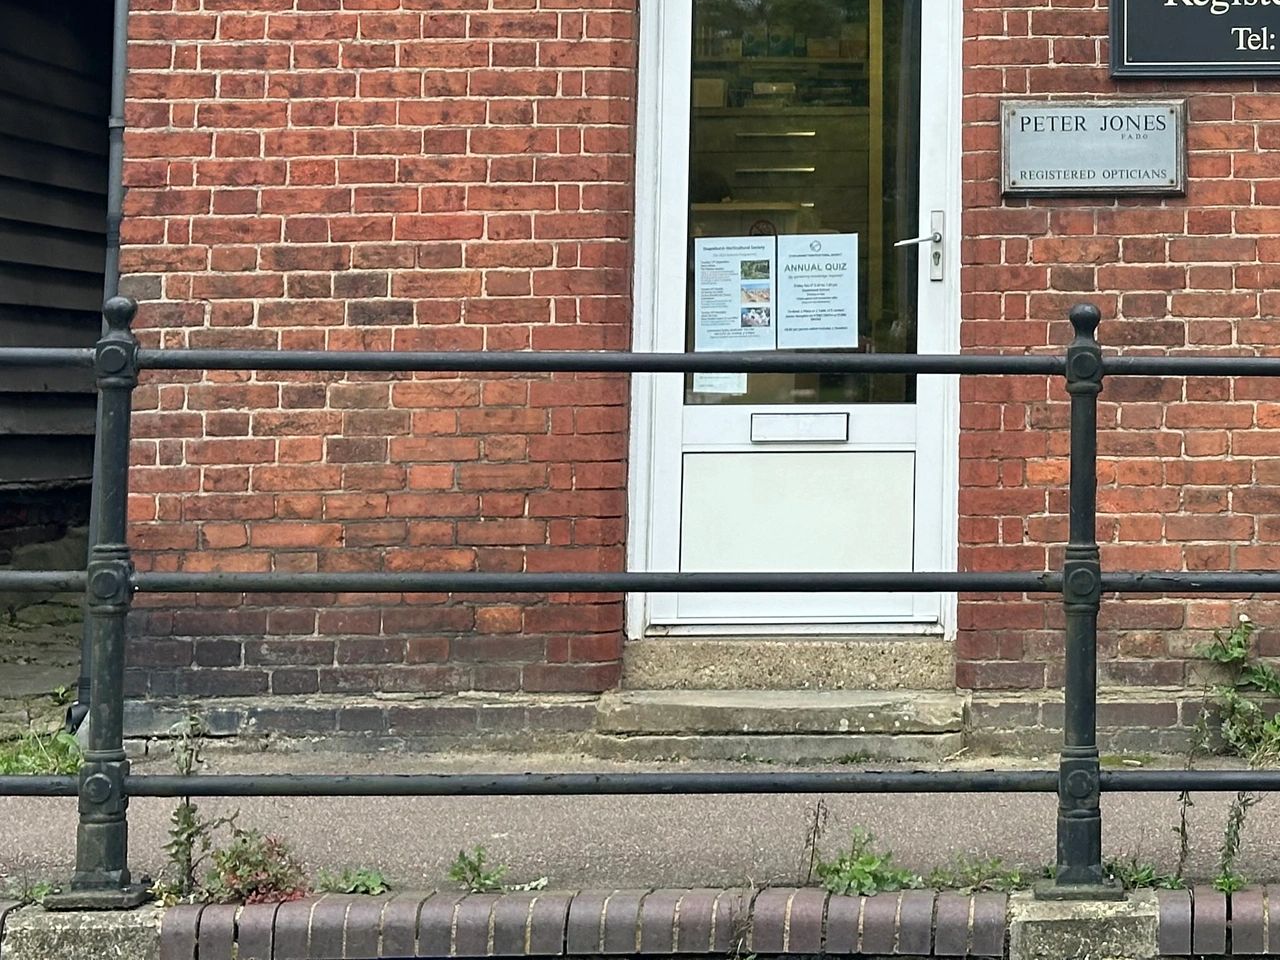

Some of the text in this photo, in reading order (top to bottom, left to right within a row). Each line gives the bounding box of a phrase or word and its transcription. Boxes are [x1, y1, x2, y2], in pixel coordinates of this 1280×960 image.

[1231, 26, 1276, 51] Tel:
[1020, 114, 1167, 132] PETER JONES
[1020, 169, 1167, 180] REGISTERED OPTICIANS
[784, 262, 848, 272] ANNUAL QUIZ
